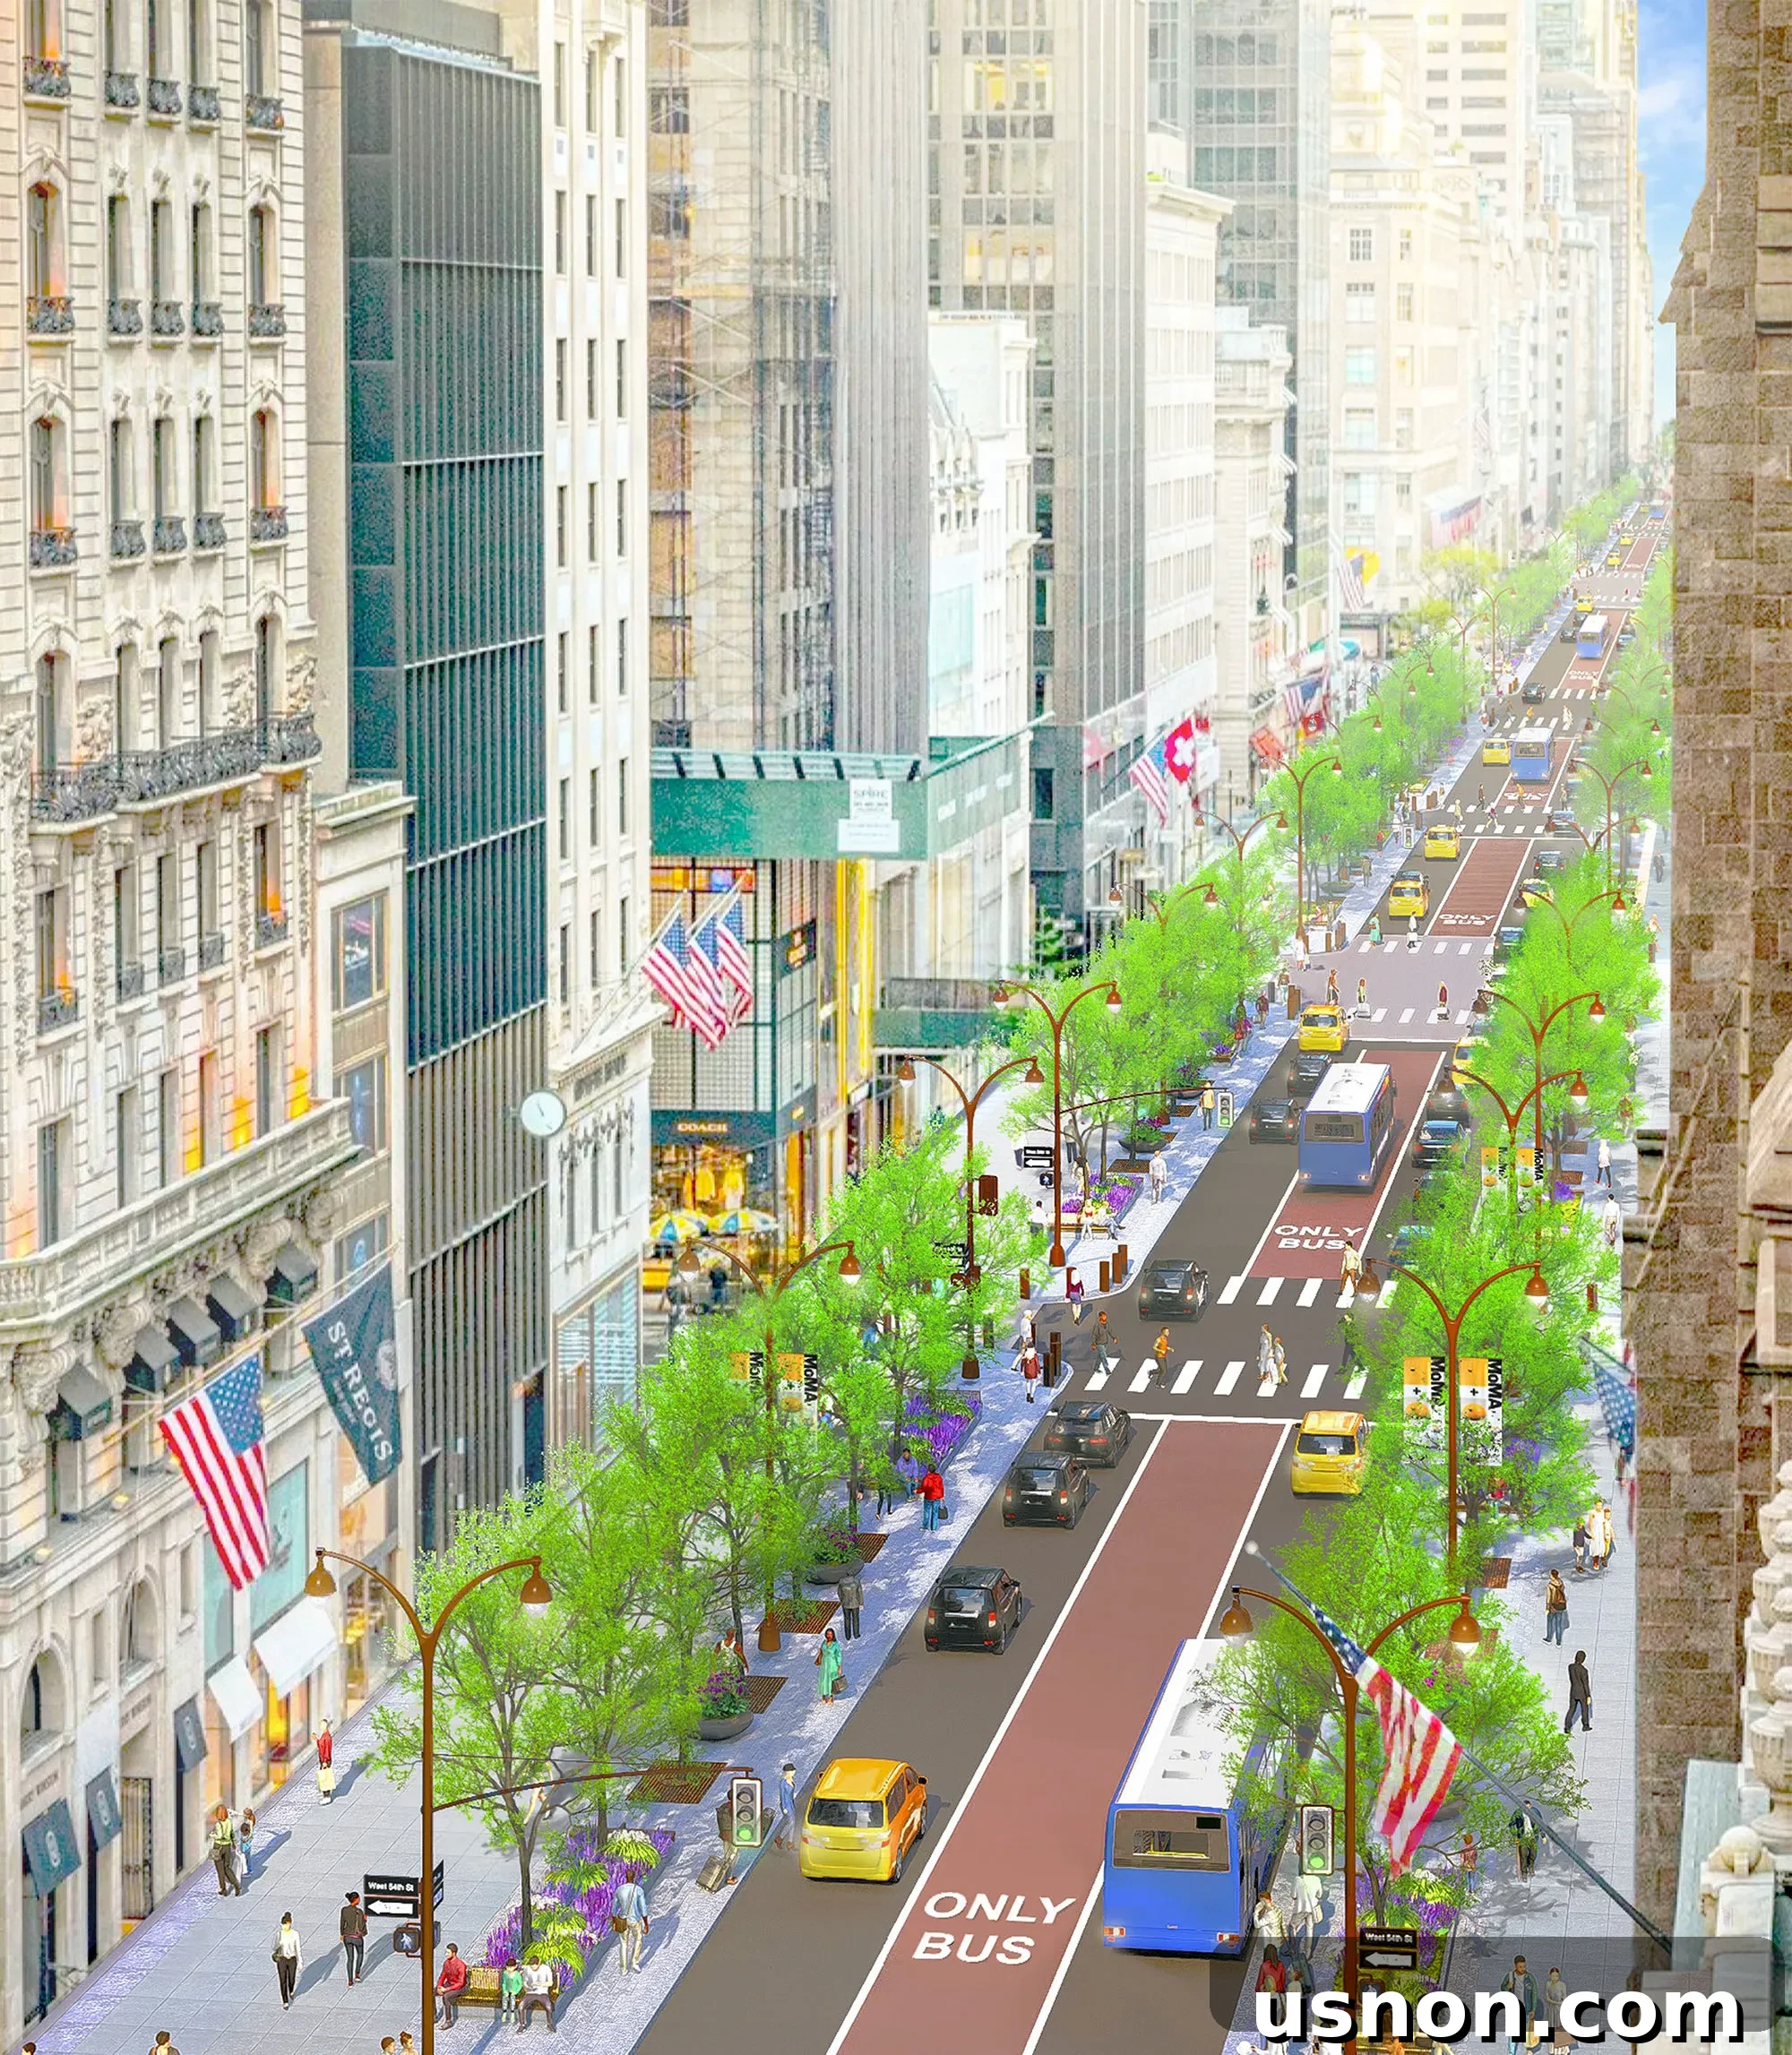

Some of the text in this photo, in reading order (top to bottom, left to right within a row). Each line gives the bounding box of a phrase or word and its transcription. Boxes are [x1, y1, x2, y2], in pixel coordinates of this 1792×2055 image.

[677, 1122, 728, 1132] COACH
[1534, 1148, 1544, 1181] MoMA
[1274, 1225, 1364, 1236] ONLY
[1278, 1237, 1346, 1250] BUS
[328, 1320, 352, 1360] ST
[804, 1354, 818, 1403] MoMA
[1488, 1359, 1503, 1410] MoMA
[367, 1881, 387, 1890] West
[405, 1883, 414, 1892] St
[924, 1892, 1076, 1924] ONLY
[912, 1931, 1035, 1965] BUS
[1365, 1933, 1385, 1941] West
[1404, 1934, 1413, 1943] St
